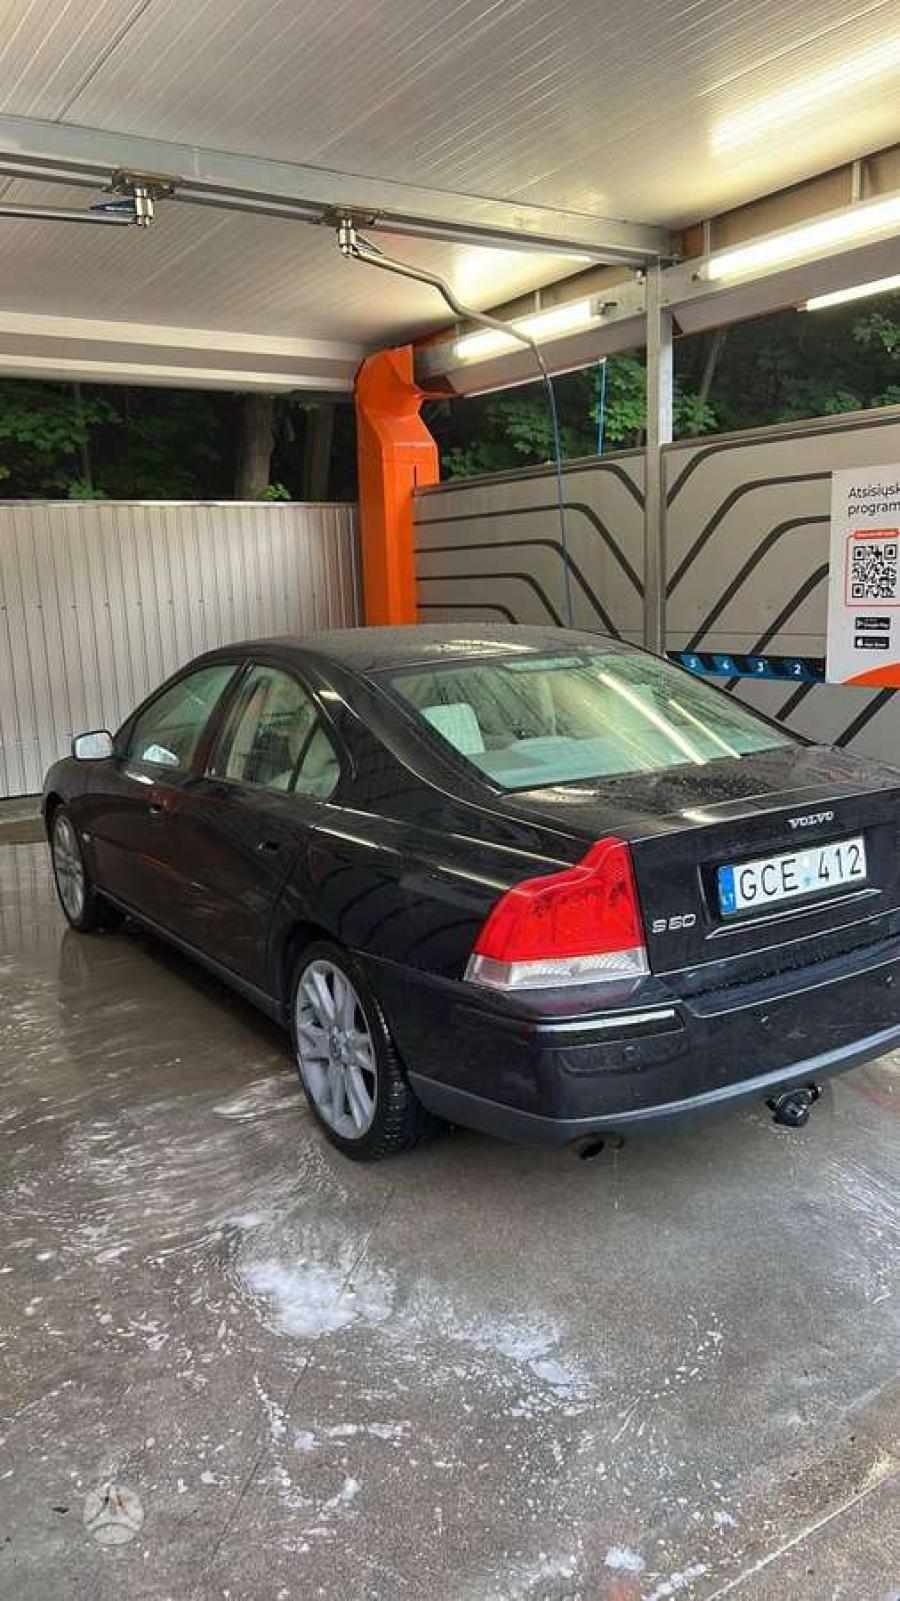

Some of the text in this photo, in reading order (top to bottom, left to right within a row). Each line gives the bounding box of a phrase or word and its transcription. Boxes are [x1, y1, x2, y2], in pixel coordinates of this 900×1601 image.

[757, 661, 764, 672] 3
[794, 663, 802, 675] 2
[787, 811, 834, 829] VOLVO
[739, 858, 798, 901] GCE
[818, 844, 862, 882] 412
